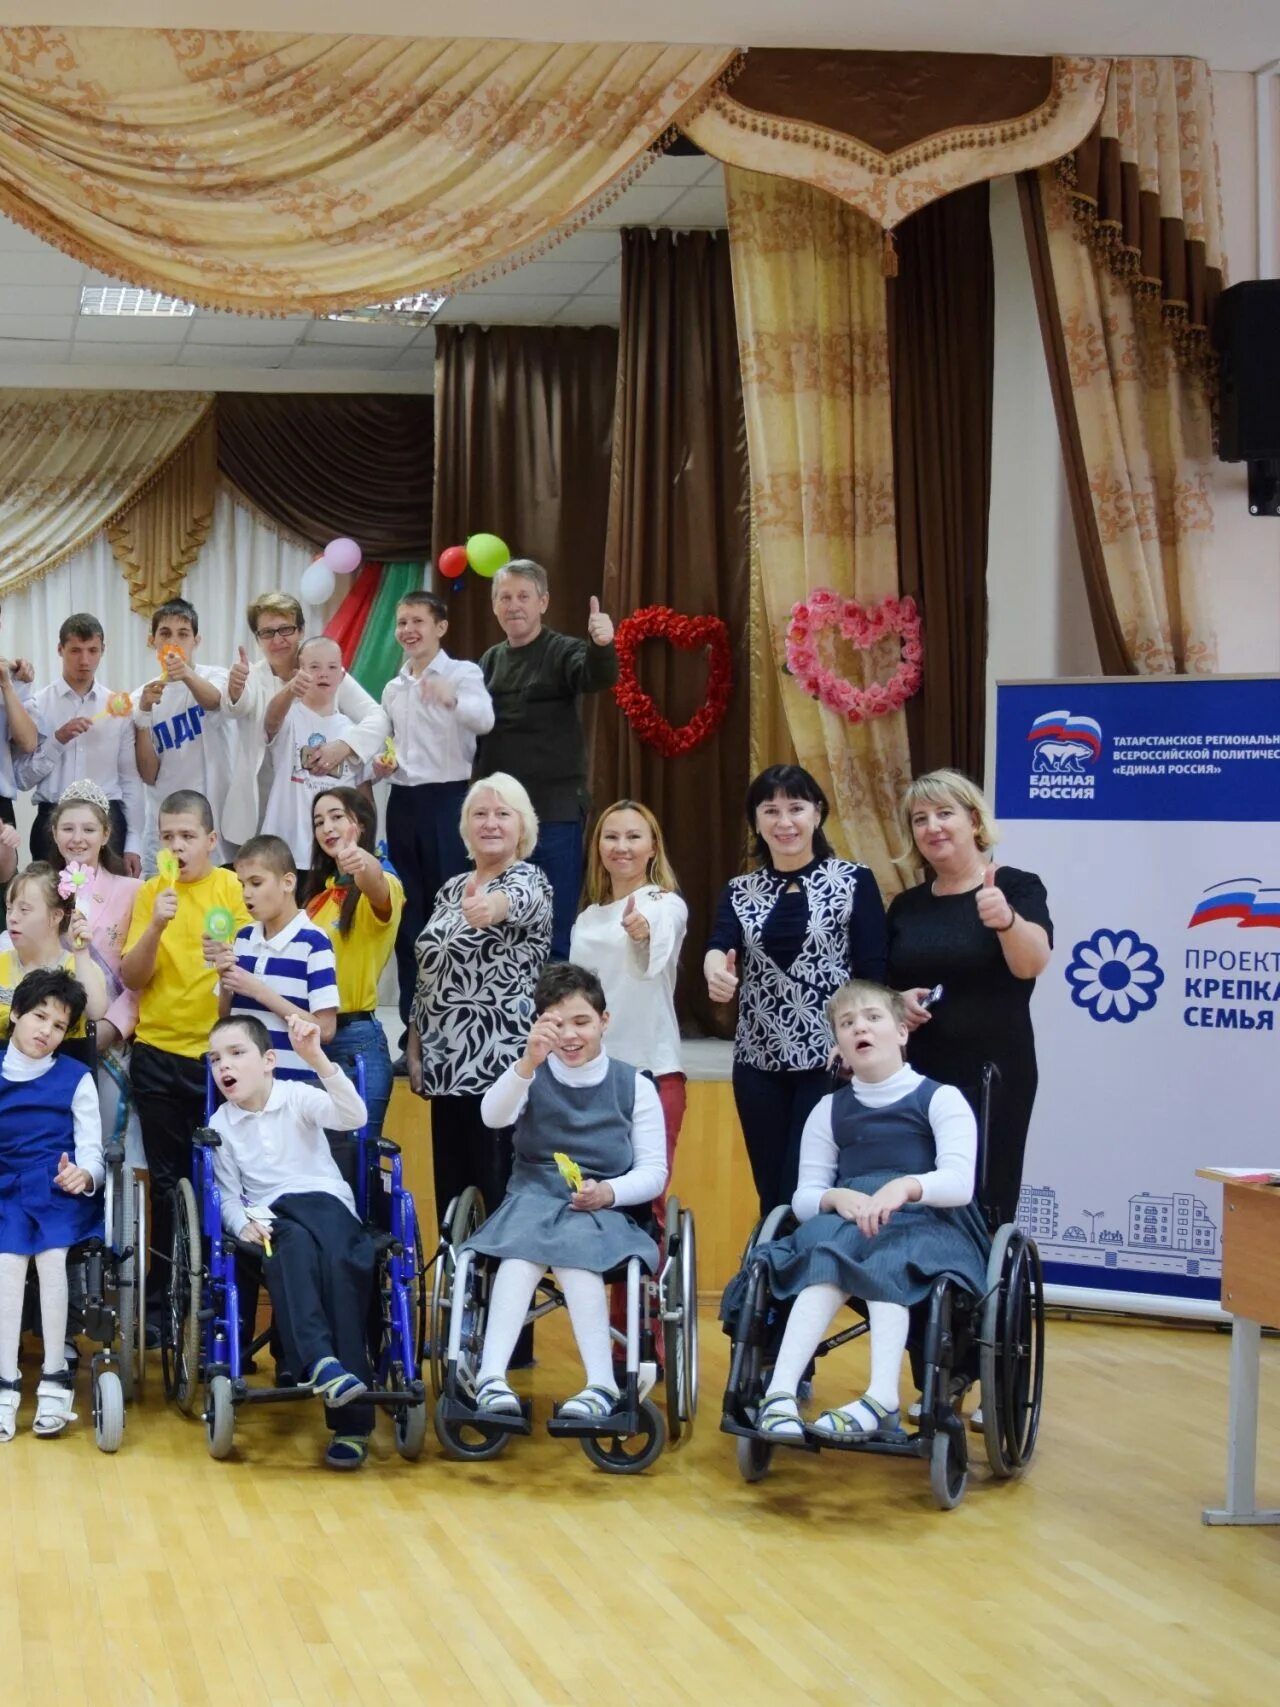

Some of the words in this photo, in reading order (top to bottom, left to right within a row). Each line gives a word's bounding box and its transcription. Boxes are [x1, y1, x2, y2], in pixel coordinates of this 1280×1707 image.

[1113, 735, 1203, 746] ТАТАРСТАНСКОЕ
[1113, 748, 1210, 761] ВСЕРОССИЙСКОЙ
[1113, 764, 1166, 777] «ЕДИНАЯ
[1168, 764, 1222, 775] РОССИЯ»
[1029, 774, 1095, 787] ЕДИНАЯ
[1029, 787, 1095, 800] РОССИЯ
[1185, 949, 1280, 972] ПРОЕКТ
[1183, 1006, 1274, 1031] СЕМЬЯ
